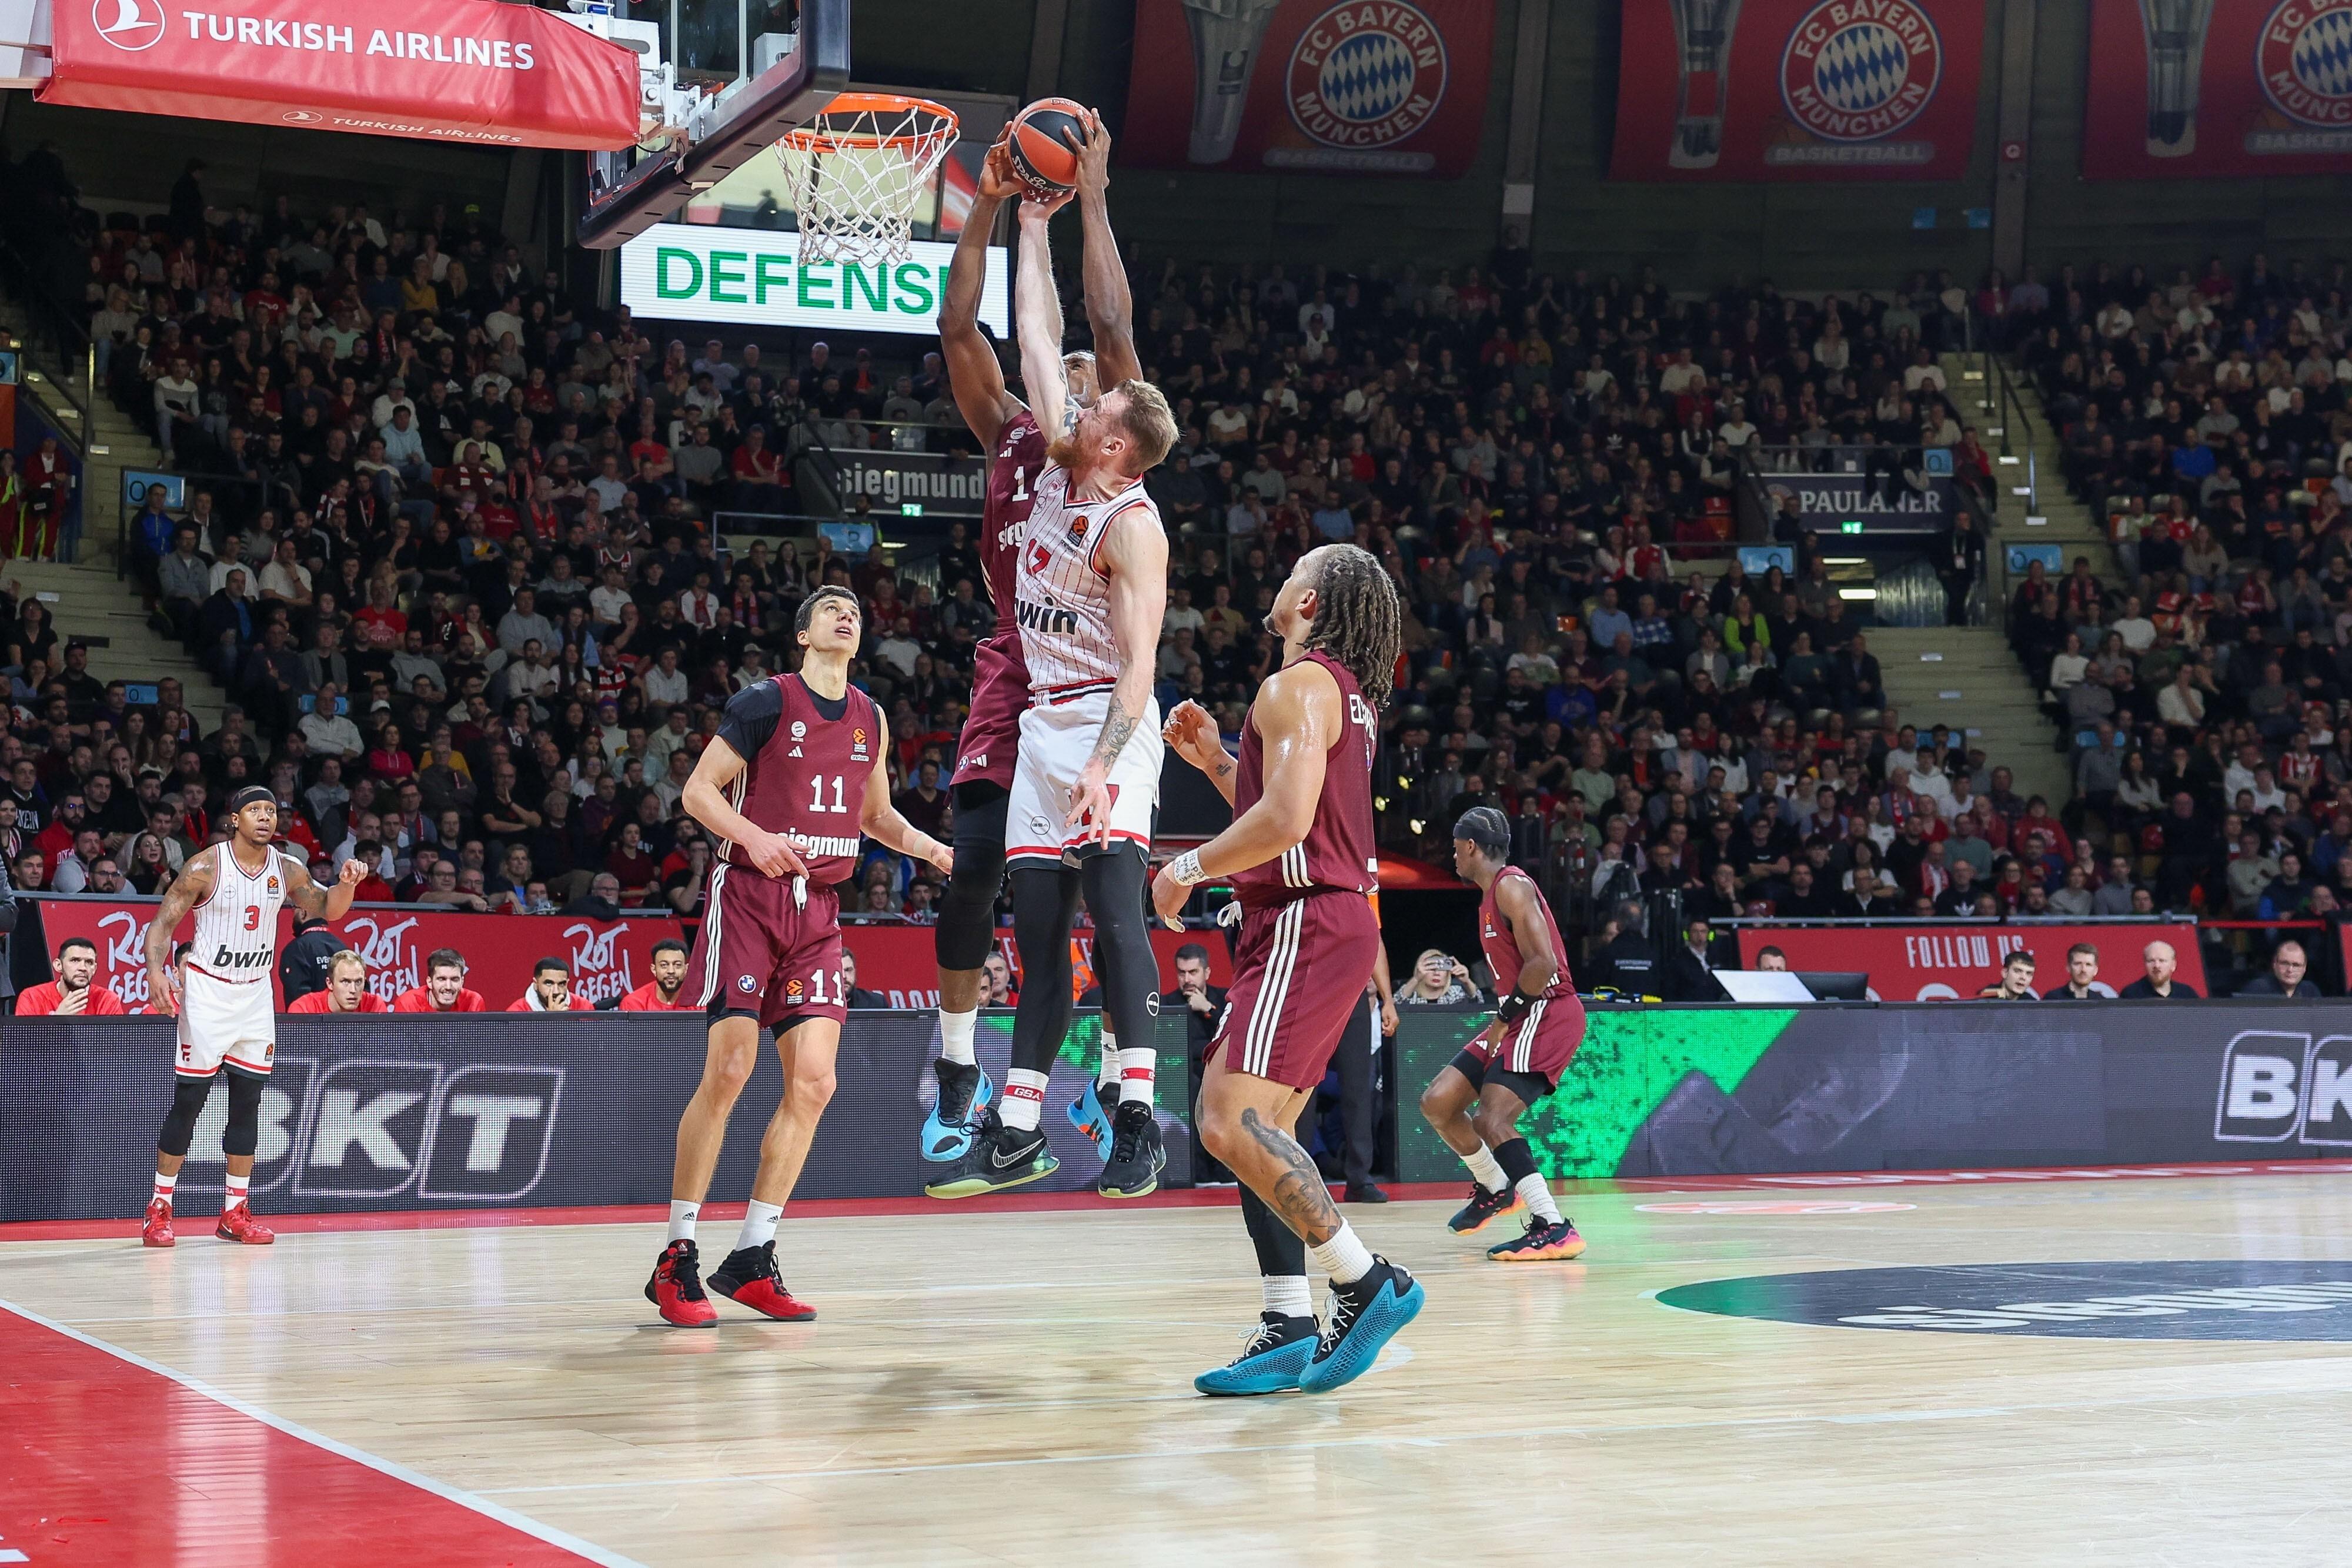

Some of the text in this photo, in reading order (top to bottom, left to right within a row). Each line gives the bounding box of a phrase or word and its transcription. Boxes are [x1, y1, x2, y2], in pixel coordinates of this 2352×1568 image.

[183, 11, 535, 71] TURKISH AIRLINES
[1300, 5, 1438, 68] FC BAYERN
[1795, 0, 1930, 58] FC BAYERN
[2271, 8, 2304, 45] FC
[333, 117, 522, 143] TURKISH AIRLINES
[657, 247, 948, 315] DEFENS
[837, 462, 985, 504] siegmund
[1015, 596, 1080, 635] win
[808, 774, 847, 814] 11
[777, 827, 861, 860] iegmun
[244, 905, 260, 931] 3
[213, 943, 273, 968] bwin
[344, 917, 419, 970] ROT
[563, 922, 630, 978] ROT
[1905, 935, 1991, 968] FOLLOW
[810, 969, 845, 1007] 11
[1014, 1088, 1040, 1101] GSA
[186, 1084, 543, 1172] BKT
